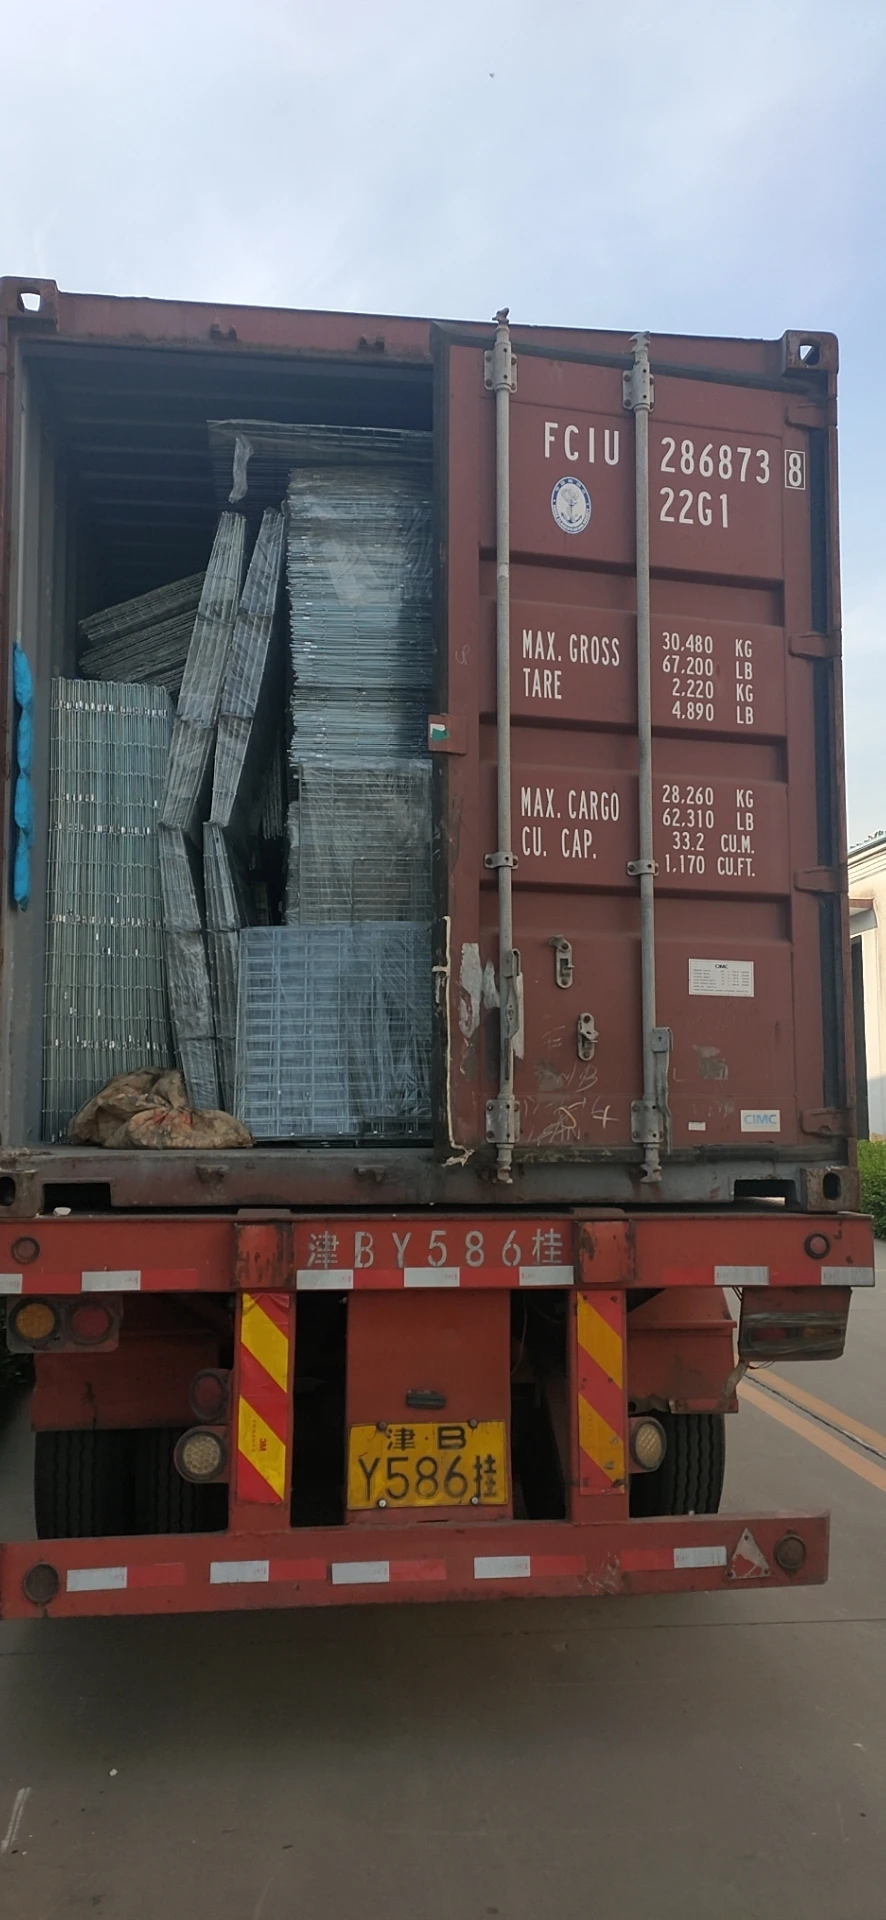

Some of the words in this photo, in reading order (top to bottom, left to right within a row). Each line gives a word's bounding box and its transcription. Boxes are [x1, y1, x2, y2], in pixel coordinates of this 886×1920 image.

[544, 422, 620, 466] FCIU
[660, 437, 770, 484] 286873
[788, 453, 802, 487] 8
[660, 487, 728, 528] 22G1
[522, 629, 562, 662] MAX.
[569, 633, 620, 666] GROSS
[662, 632, 713, 654] 30,480
[735, 638, 752, 658] KG
[662, 655, 713, 676] 67,200
[736, 661, 753, 680] LB
[523, 668, 562, 699] TARE
[672, 678, 714, 699] 2,220
[736, 683, 753, 702] KG
[671, 700, 714, 722] 4,890
[736, 705, 754, 724] LB
[521, 787, 561, 818] MAX.
[568, 789, 620, 821] CARGO
[662, 784, 714, 806] 28,260
[736, 788, 754, 808] KG
[662, 808, 714, 829] 62,310
[736, 812, 754, 831] LB
[522, 826, 547, 857] CU.
[561, 828, 597, 859] CAP.
[672, 831, 705, 851] 33.2
[720, 834, 755, 854] CU.M.
[665, 853, 705, 875] 1,170
[717, 857, 756, 877] CU.FT.
[743, 1114, 777, 1125] CIMC
